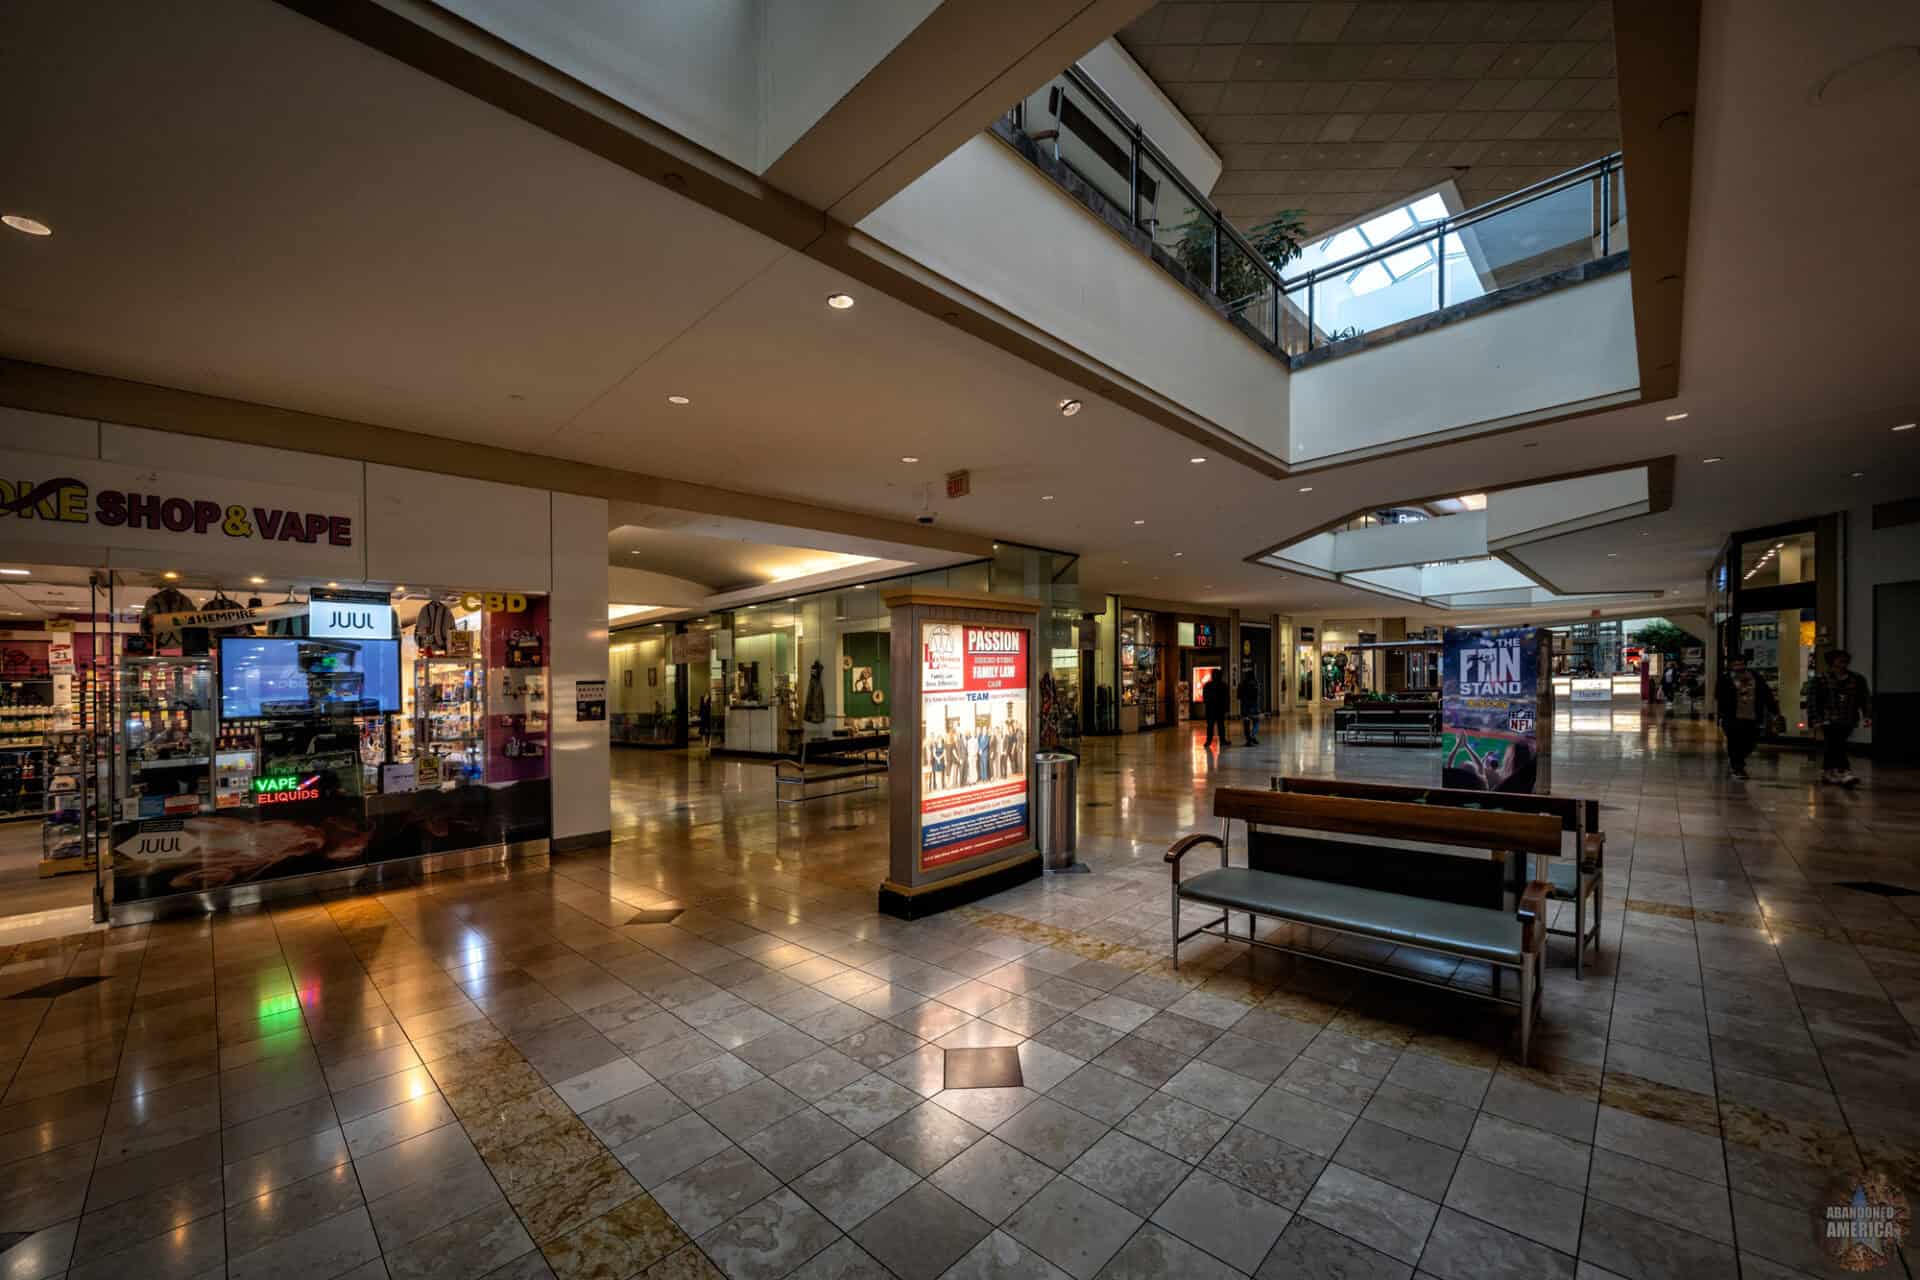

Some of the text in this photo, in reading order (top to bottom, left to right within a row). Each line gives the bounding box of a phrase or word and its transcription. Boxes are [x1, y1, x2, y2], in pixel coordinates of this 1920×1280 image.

[461, 592, 528, 613] CBD
[328, 610, 375, 630] JUUL
[968, 630, 1020, 651] PASSION
[1495, 638, 1521, 648] THE
[1460, 681, 1522, 696] STAND
[966, 692, 989, 702] TEAM
[1510, 719, 1533, 731] NFL
[256, 776, 298, 791] VAPE
[258, 788, 319, 805] ELIQUIDS
[138, 836, 182, 855] JUUL
